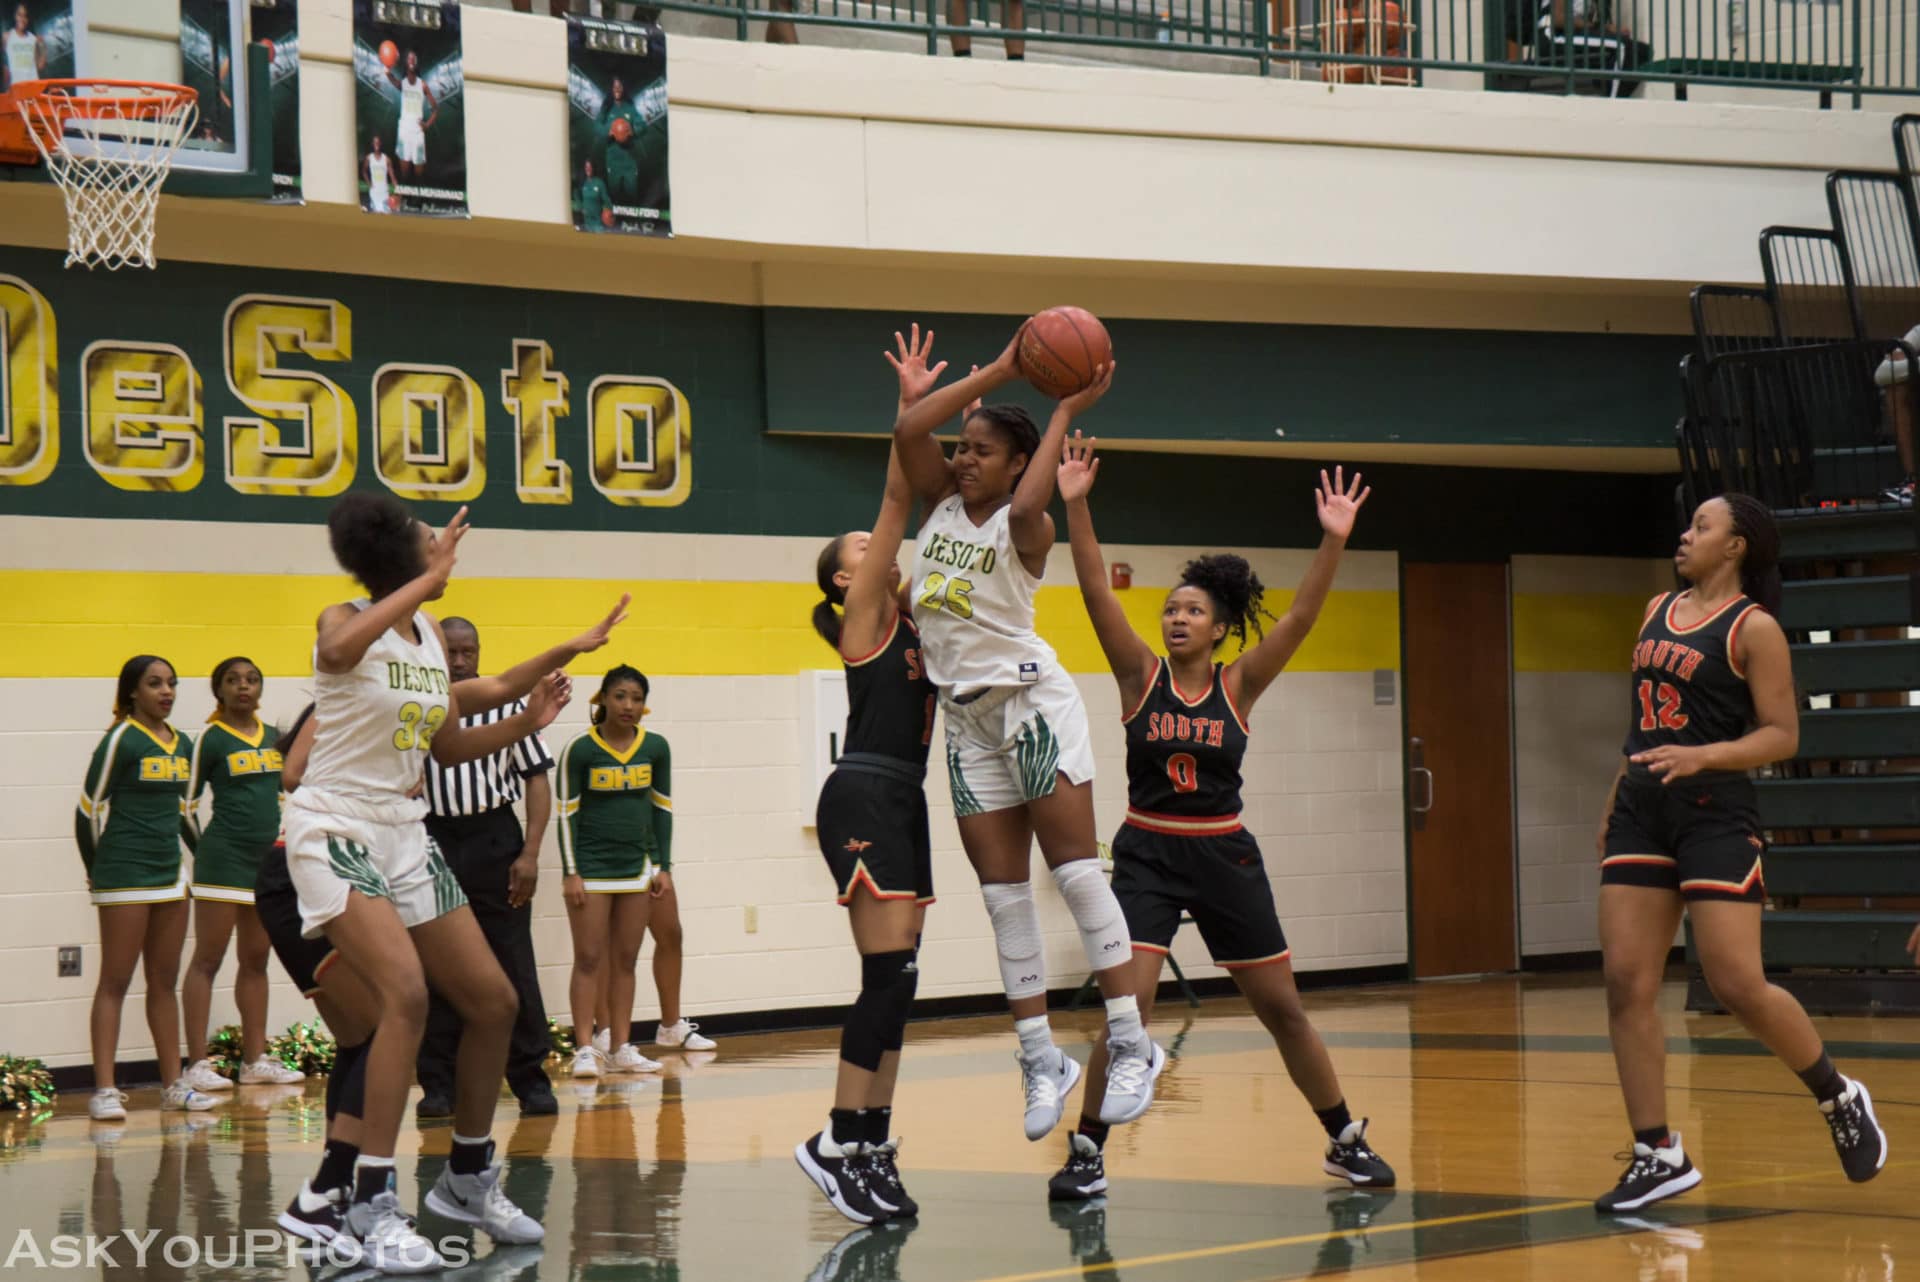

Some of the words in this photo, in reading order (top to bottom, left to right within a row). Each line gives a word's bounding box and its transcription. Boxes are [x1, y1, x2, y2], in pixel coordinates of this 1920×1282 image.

[923, 533, 996, 574] DESOTO
[919, 571, 975, 619] 25
[1632, 638, 1705, 682] SOUTH
[1638, 679, 1689, 731] 12
[392, 701, 446, 752] 32
[1146, 711, 1225, 748] SOUTH
[139, 755, 191, 782] DHS
[227, 748, 284, 777] DHS
[588, 763, 653, 791] DHS
[1166, 752, 1198, 793] 0
